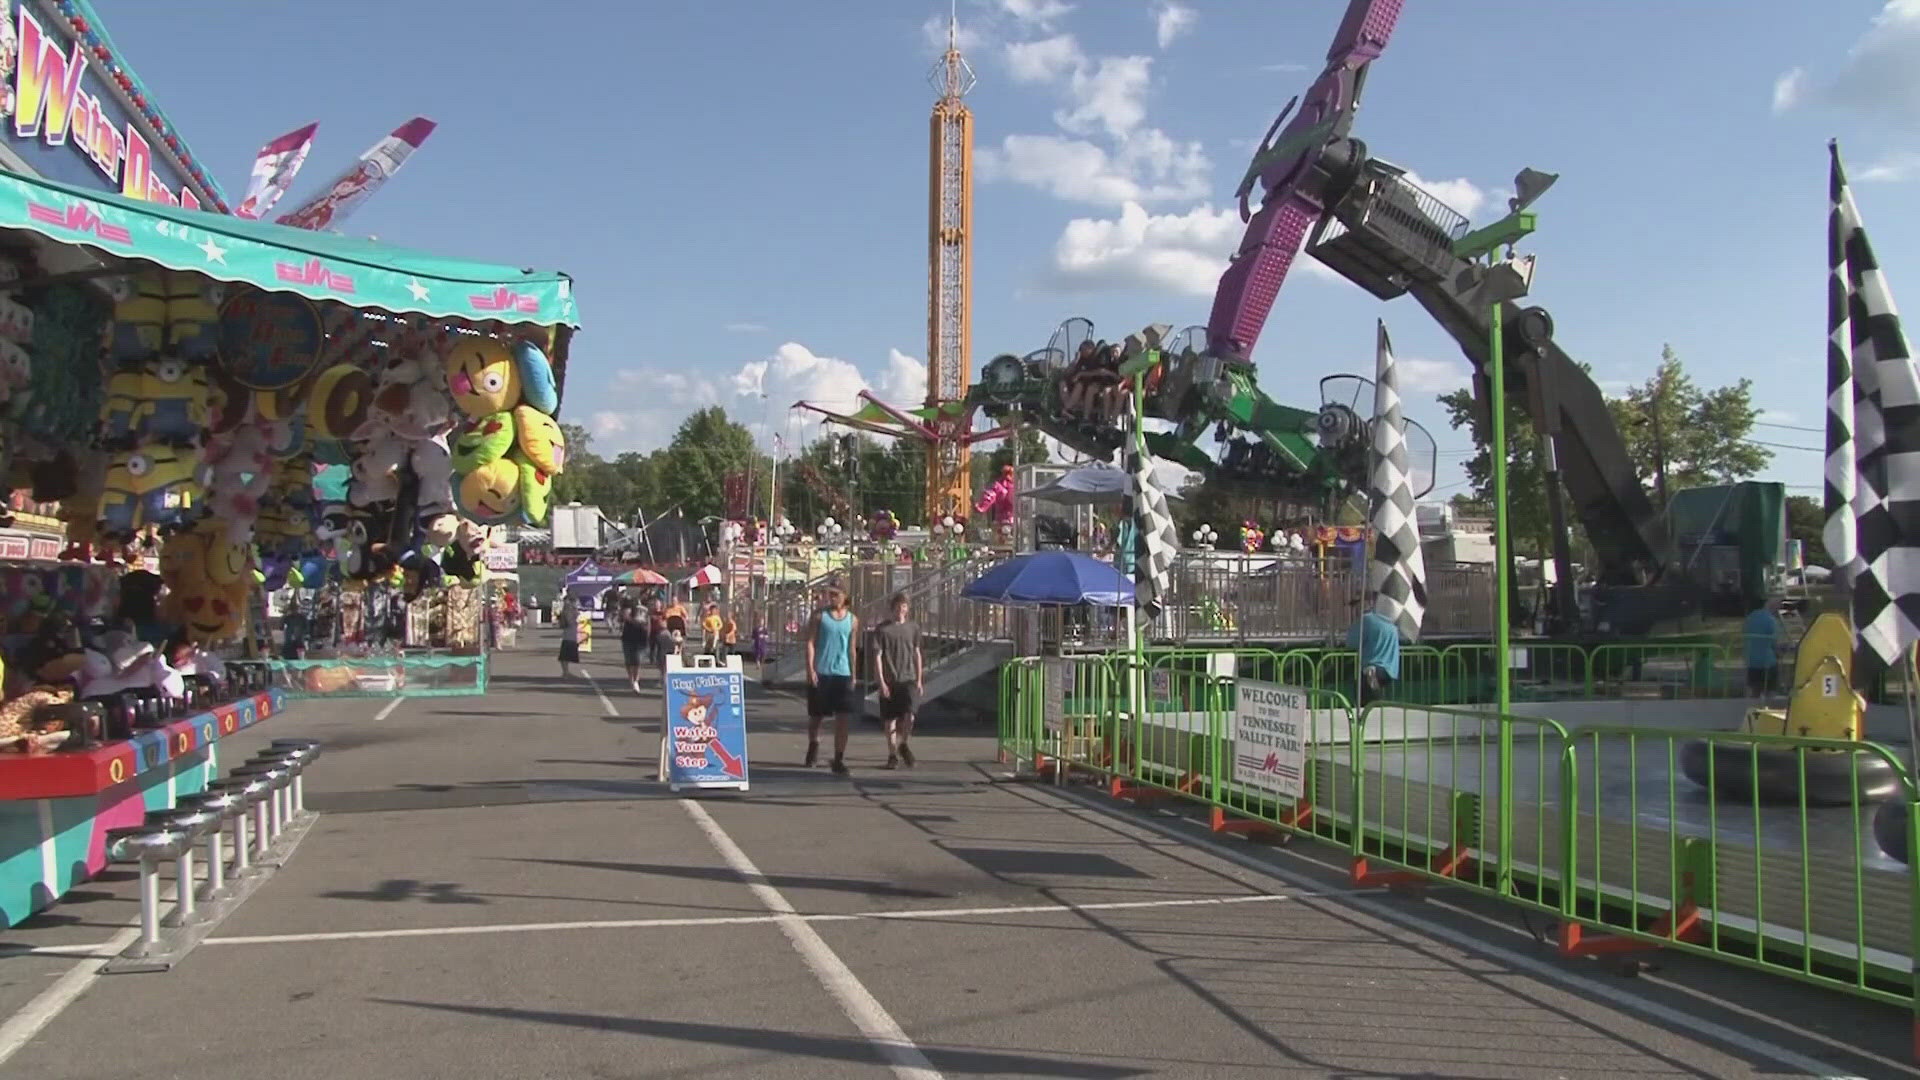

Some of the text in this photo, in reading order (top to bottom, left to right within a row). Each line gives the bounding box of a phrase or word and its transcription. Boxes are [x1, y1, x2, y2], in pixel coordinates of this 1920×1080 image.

[16, 4, 125, 183] Water
[672, 679, 696, 690] Hey
[1824, 677, 1832, 694] 5
[1241, 687, 1299, 709] WELCOME
[1258, 706, 1281, 717] TO THE
[673, 726, 718, 738] Watch
[1242, 715, 1297, 736] TENNESSEE
[1239, 729, 1273, 746] VALLEY
[674, 741, 707, 752] Your
[675, 756, 708, 768] Step
